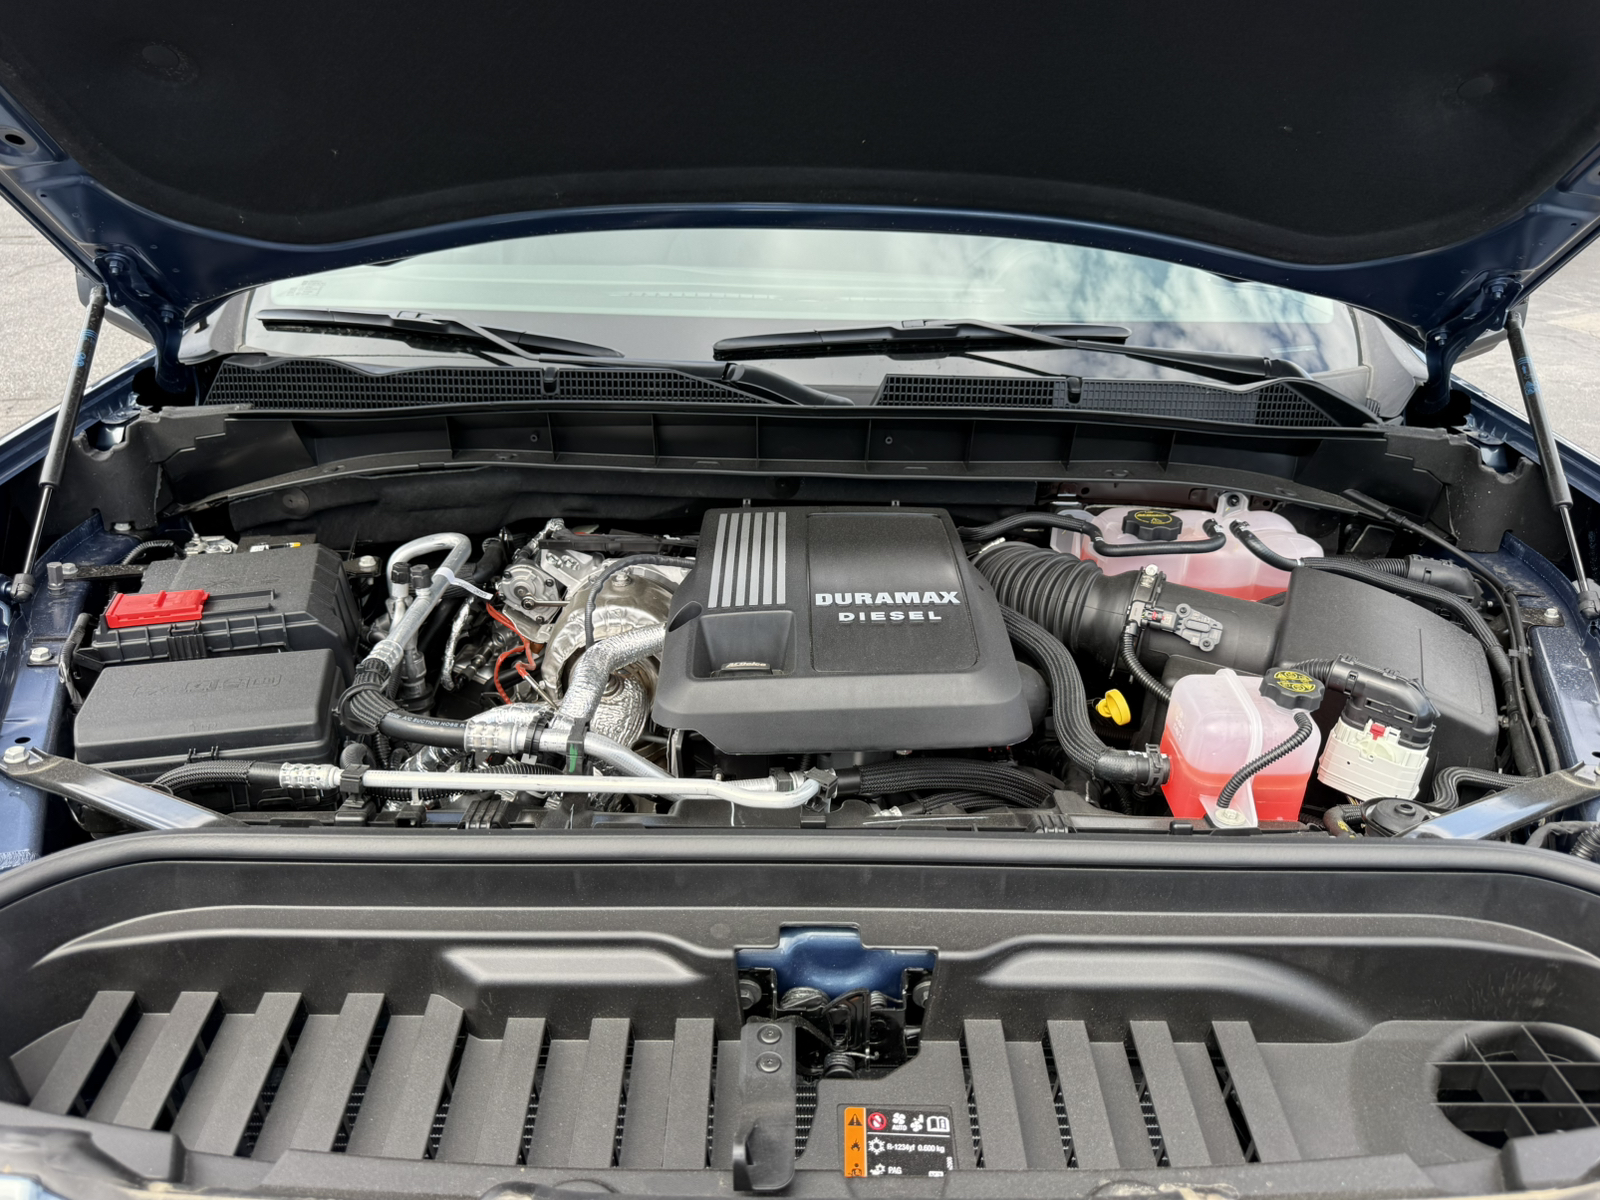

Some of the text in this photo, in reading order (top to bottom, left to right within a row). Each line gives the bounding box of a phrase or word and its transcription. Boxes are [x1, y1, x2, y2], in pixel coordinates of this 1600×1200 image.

[815, 591, 961, 606] DURAMAX
[838, 611, 942, 622] DIESEL
[886, 1143, 915, 1153] R-1234yf
[936, 1145, 945, 1153] kg
[888, 1166, 902, 1174] PAG
